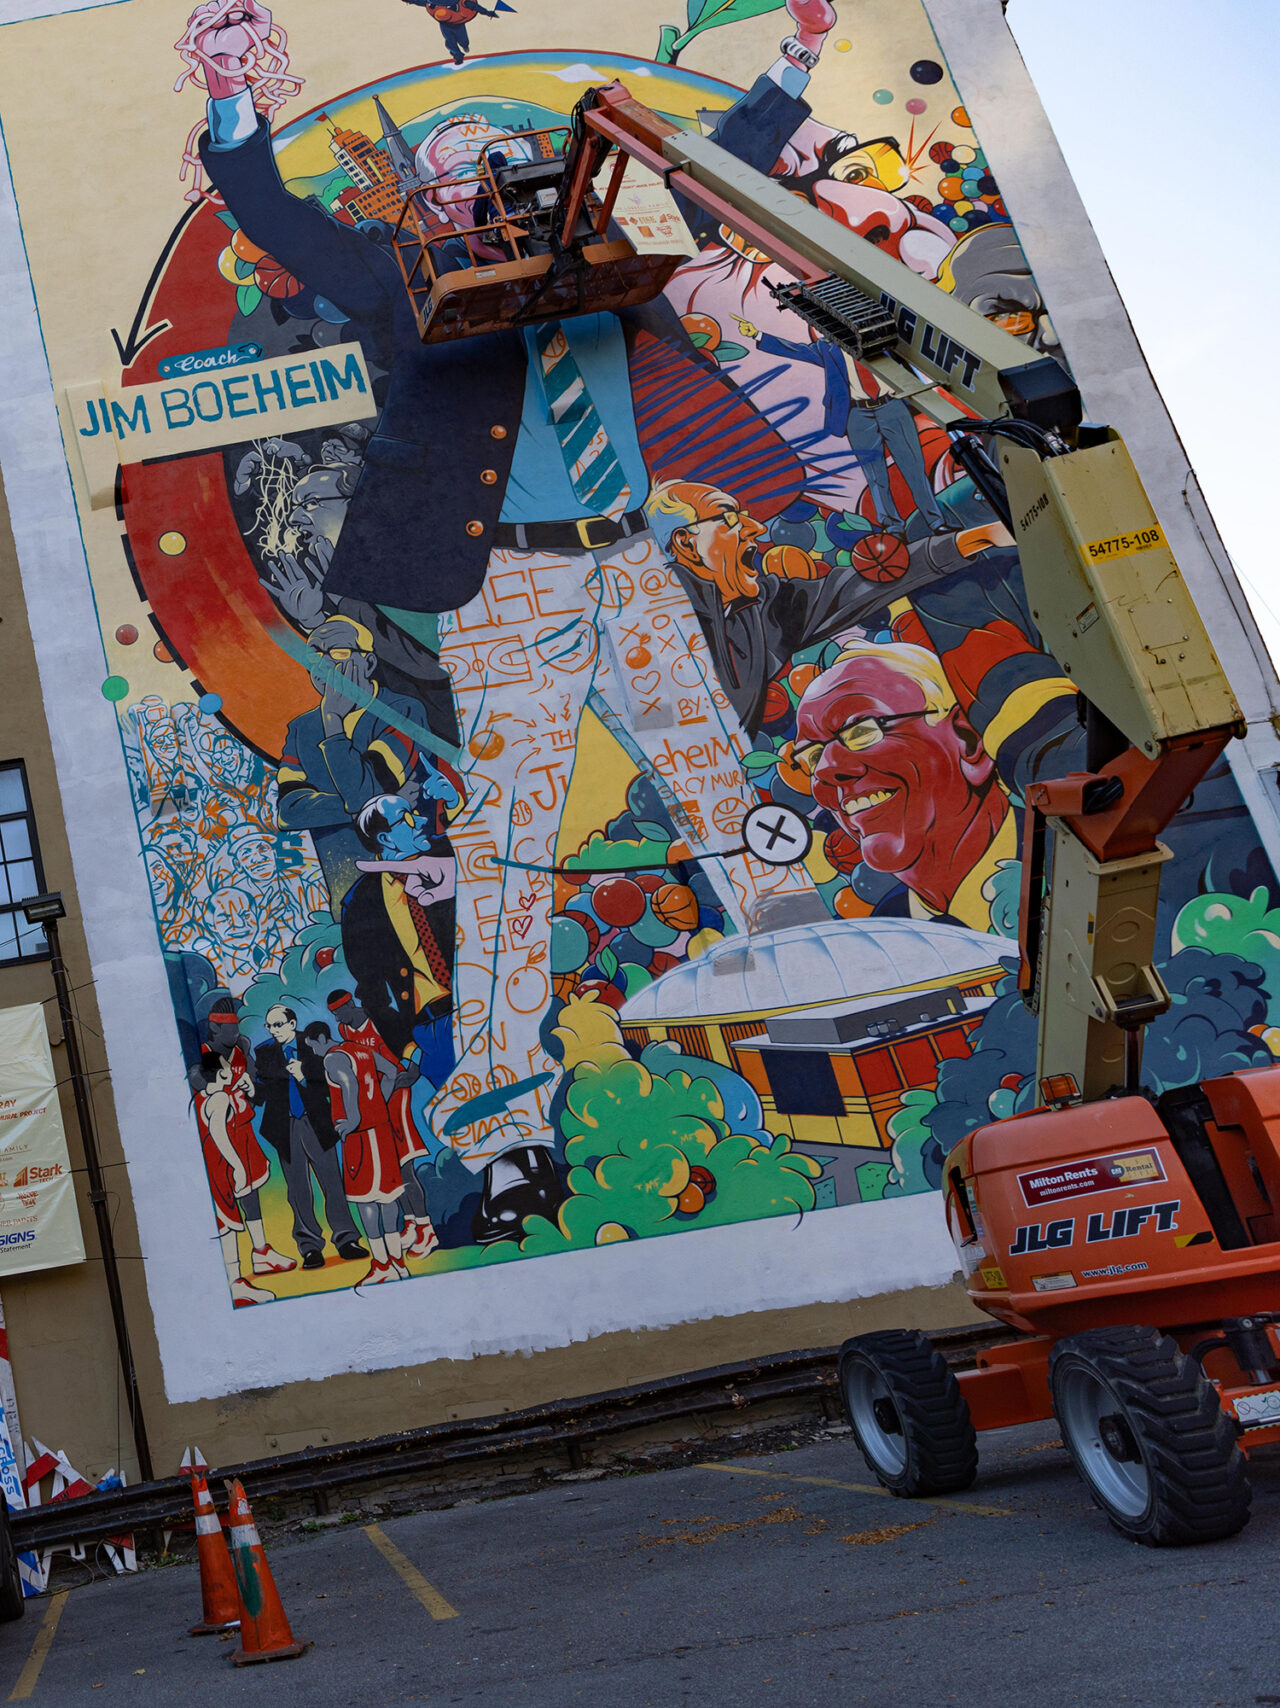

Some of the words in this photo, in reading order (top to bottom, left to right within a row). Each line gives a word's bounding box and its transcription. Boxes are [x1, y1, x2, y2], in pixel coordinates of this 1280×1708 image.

[920, 322, 982, 390] LIFT
[79, 394, 152, 440] JIM
[160, 353, 368, 430] BOEHEIM
[1089, 530, 1160, 557] 54775-108
[29, 1163, 63, 1179] Stark
[1029, 1174, 1064, 1189] Milton
[1064, 1166, 1098, 1183] Rents
[1125, 1162, 1153, 1173] Rental
[1039, 1179, 1095, 1197] miltonrents.com
[1009, 1218, 1075, 1256] JLG
[1086, 1200, 1181, 1243] LIFT
[0, 1243, 31, 1254] Statement
[1081, 1261, 1148, 1278] www.jlg.com
